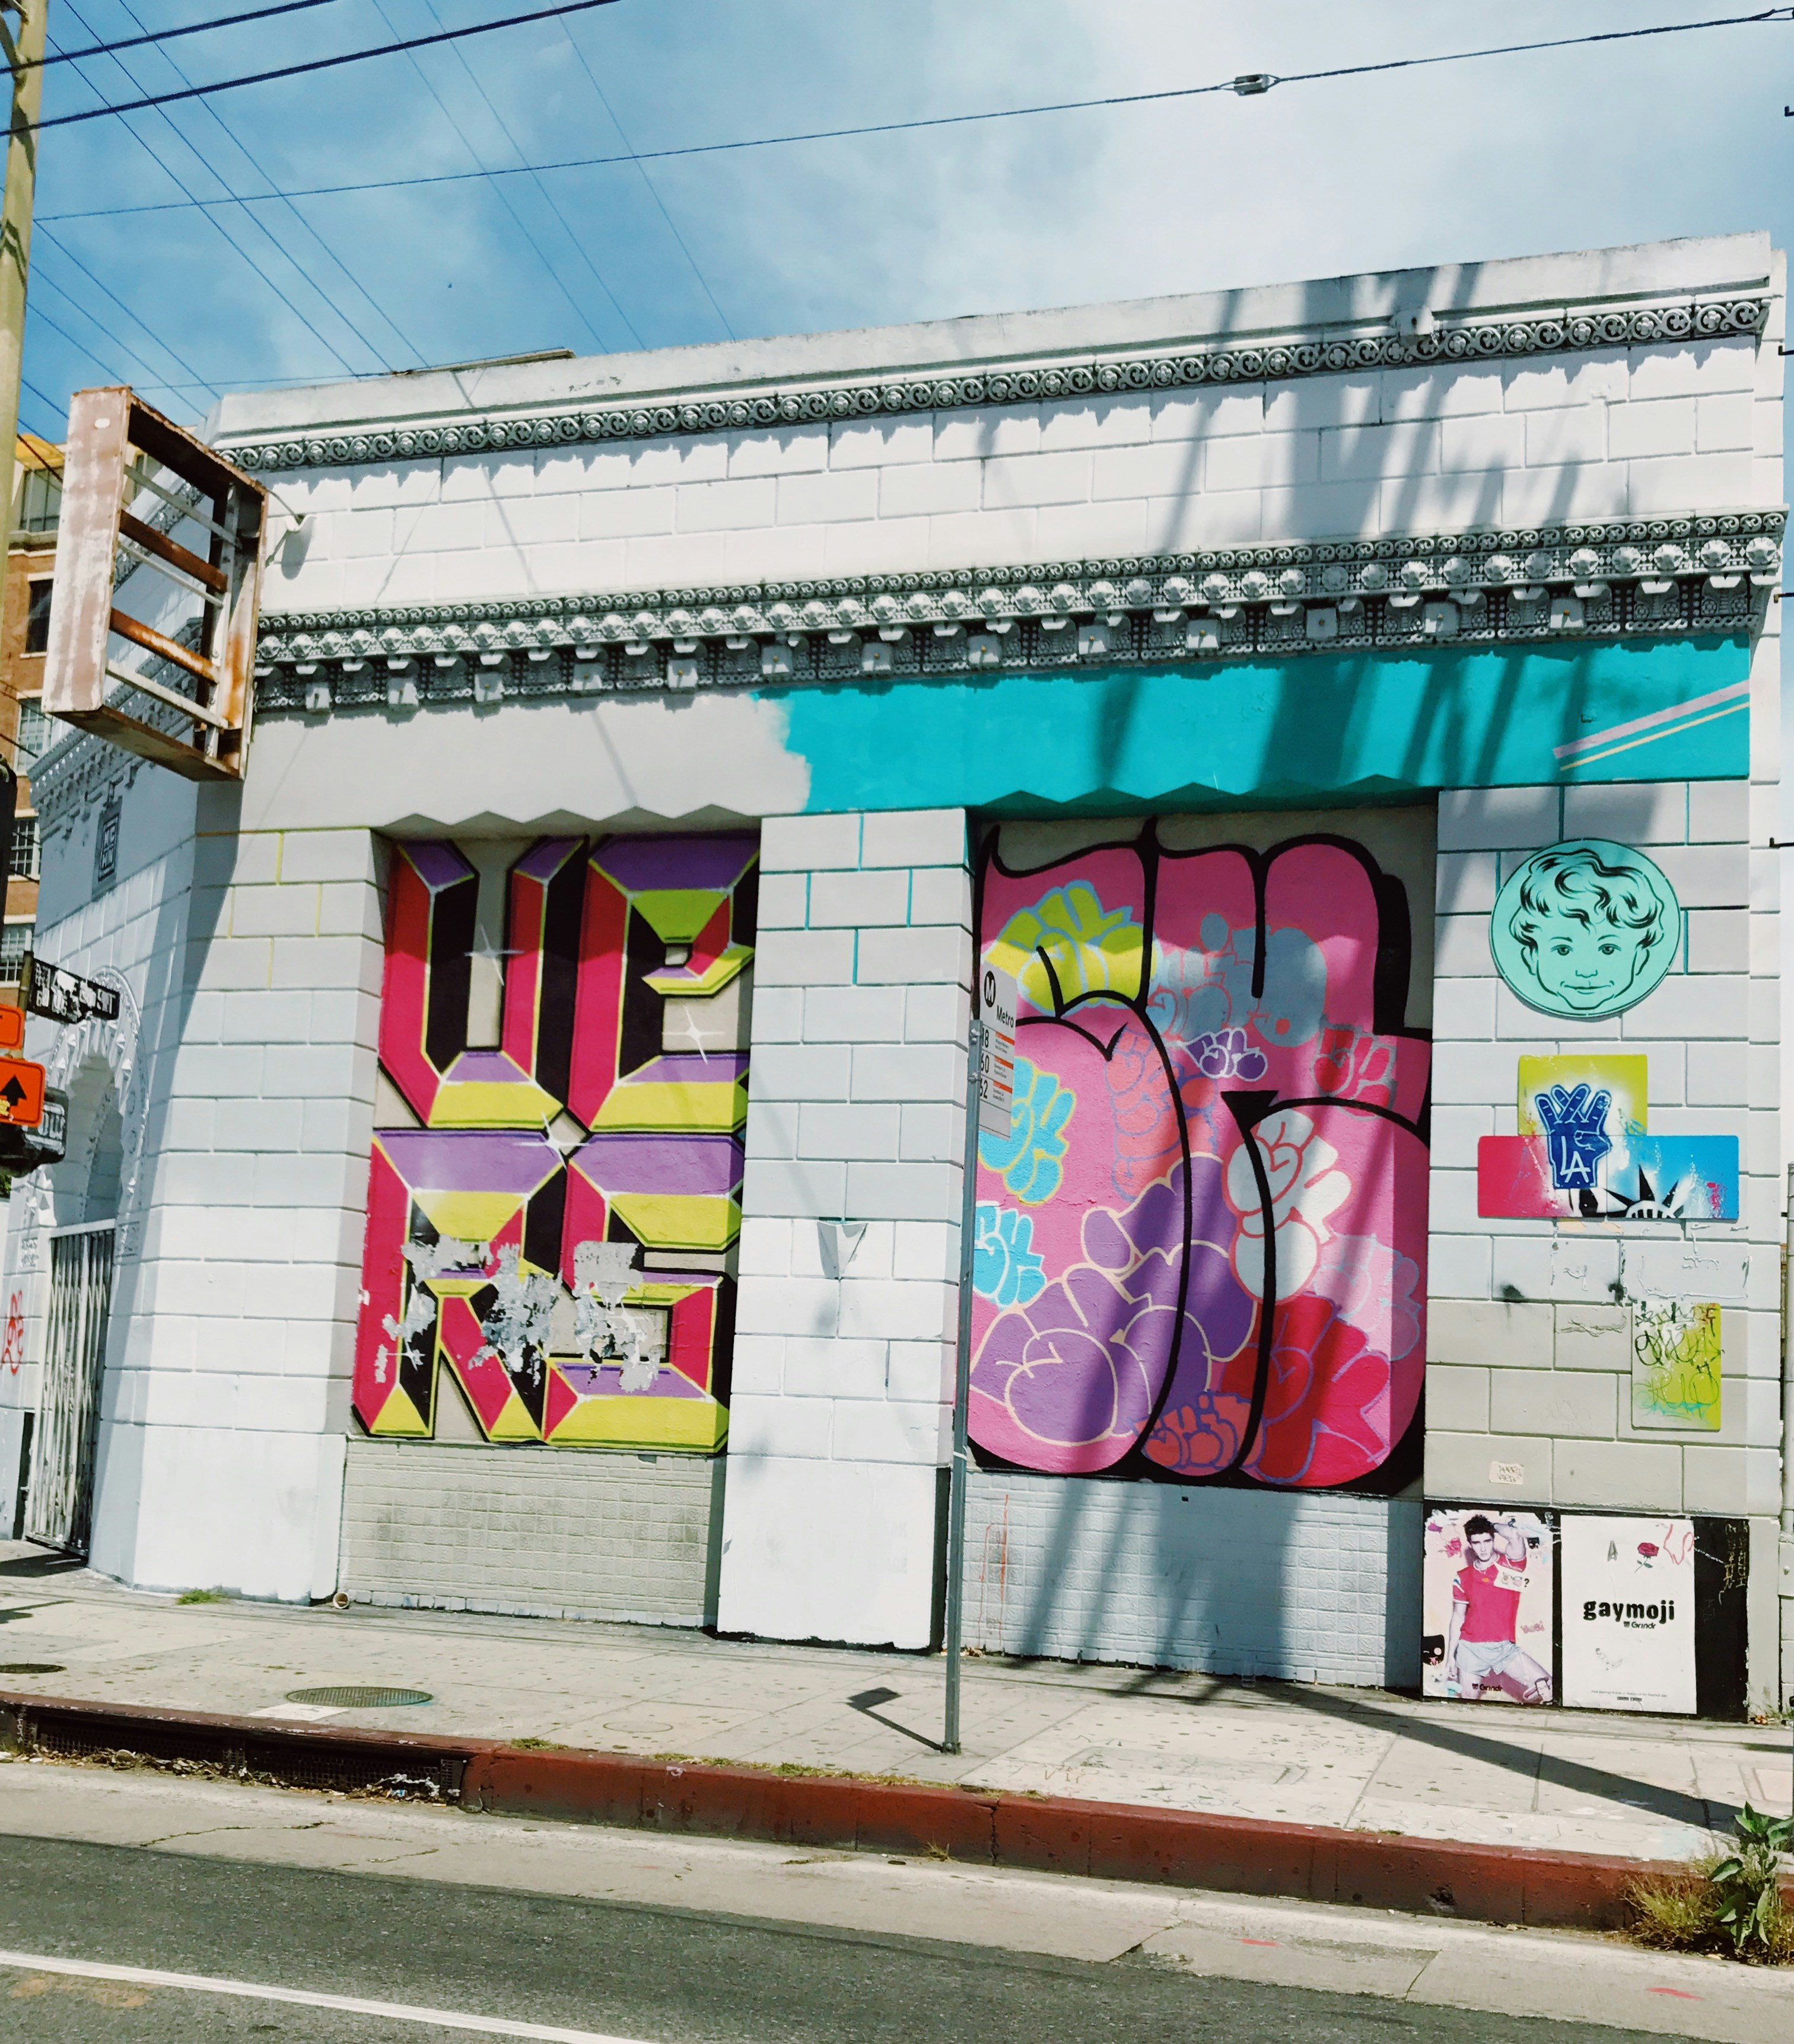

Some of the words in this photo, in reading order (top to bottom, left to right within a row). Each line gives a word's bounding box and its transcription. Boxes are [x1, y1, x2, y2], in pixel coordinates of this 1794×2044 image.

[986, 976, 994, 1004] M
[996, 1005, 1014, 1028] Metro
[1560, 1135, 1591, 1183] LA
[1583, 1600, 1675, 1624] gaymoji
[1631, 1621, 1656, 1629] Grindr
[1479, 1683, 1503, 1692] Grindr
